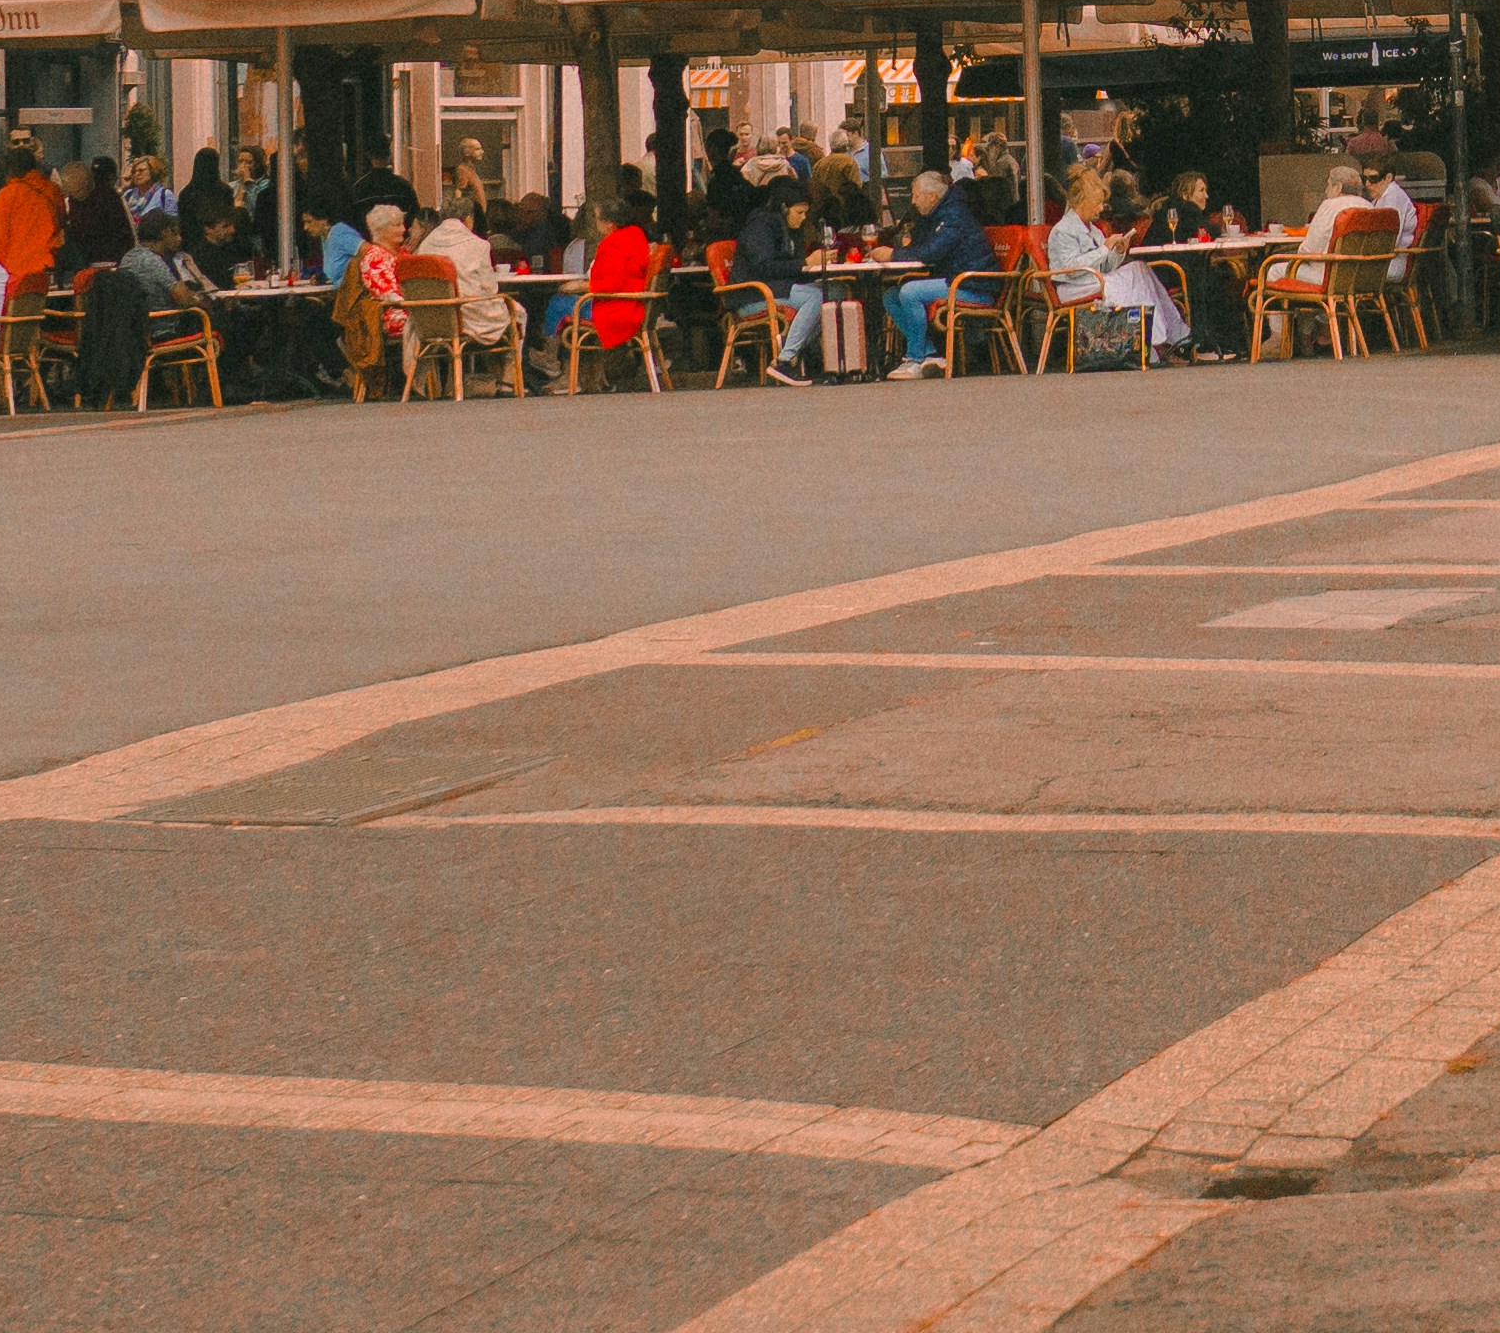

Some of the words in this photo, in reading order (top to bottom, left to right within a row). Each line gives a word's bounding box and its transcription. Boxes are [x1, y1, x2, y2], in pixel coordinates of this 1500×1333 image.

[1322, 51, 1339, 61] We
[1341, 51, 1368, 61] serve
[1382, 49, 1400, 58] ICE
